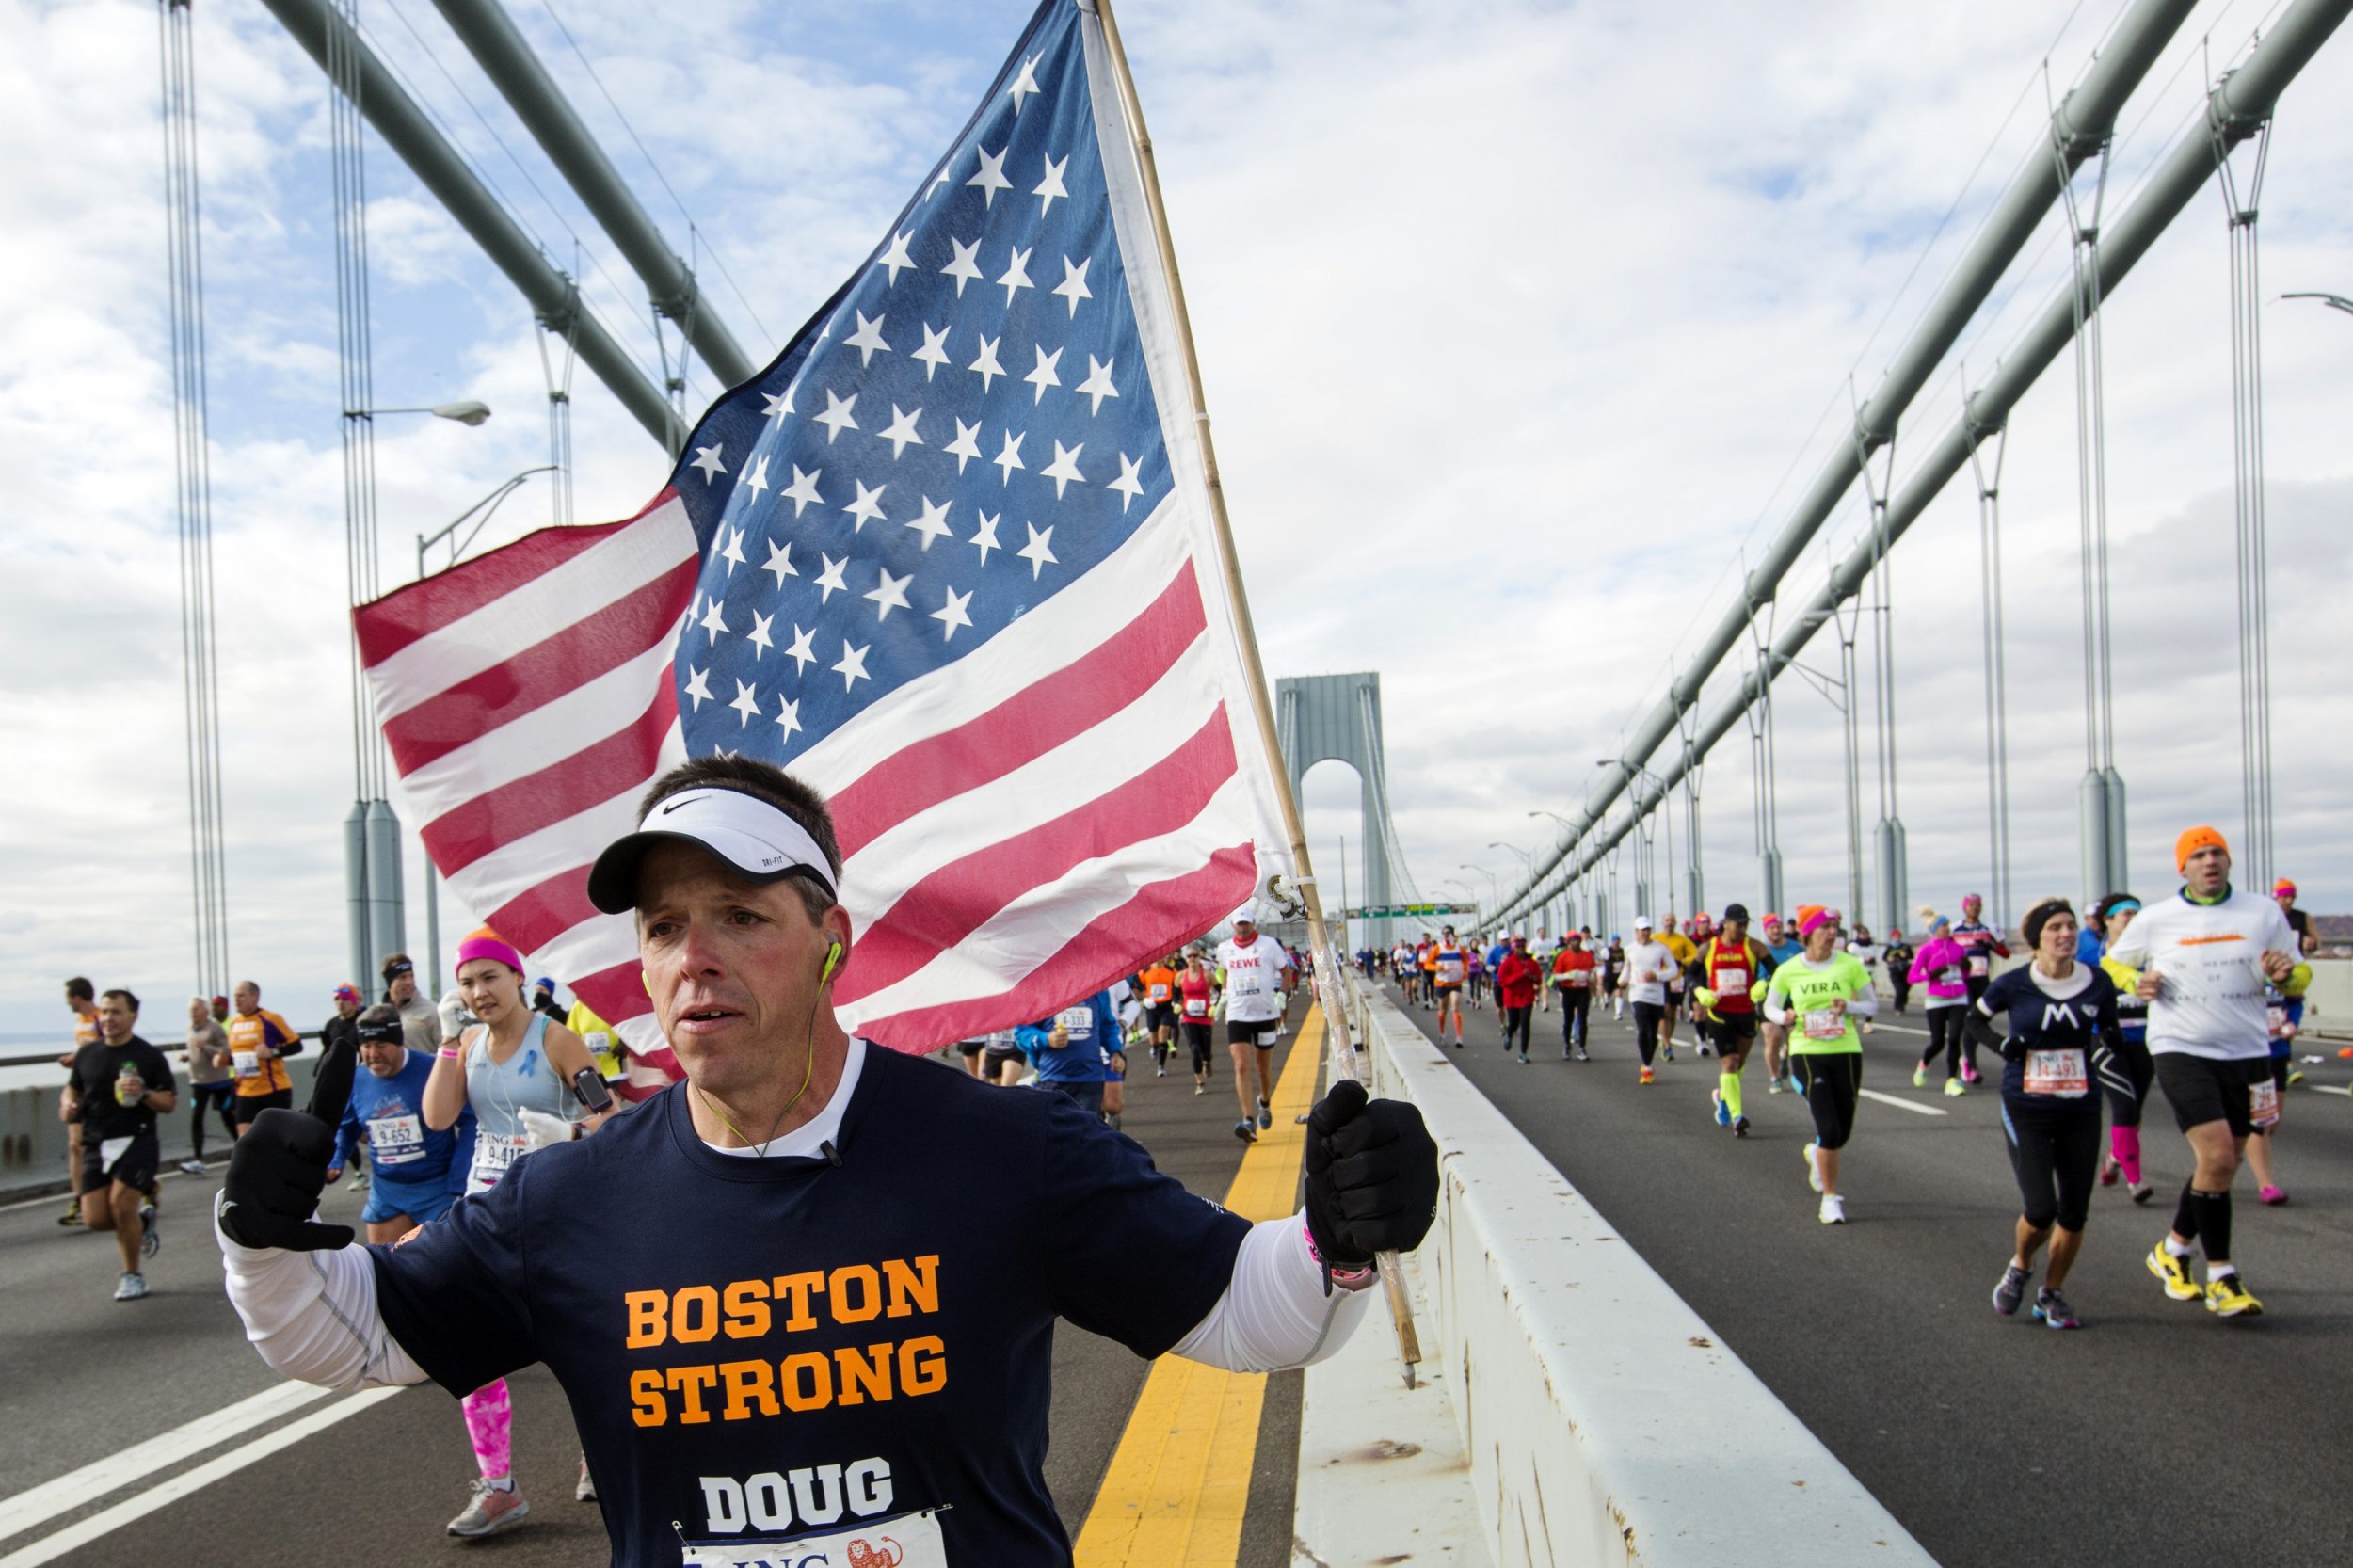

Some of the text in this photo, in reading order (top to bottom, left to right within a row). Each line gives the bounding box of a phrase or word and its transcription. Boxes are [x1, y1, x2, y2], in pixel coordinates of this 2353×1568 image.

[762, 856, 783, 867] DRI-FIT
[1229, 957, 1261, 969] REWE
[1800, 981, 1841, 995] VERA
[379, 1128, 413, 1144] 9-652
[487, 1133, 509, 1145] ING
[625, 1254, 940, 1350] BOSTON
[630, 1335, 948, 1428] STRONG
[699, 1456, 894, 1534] DOUG
